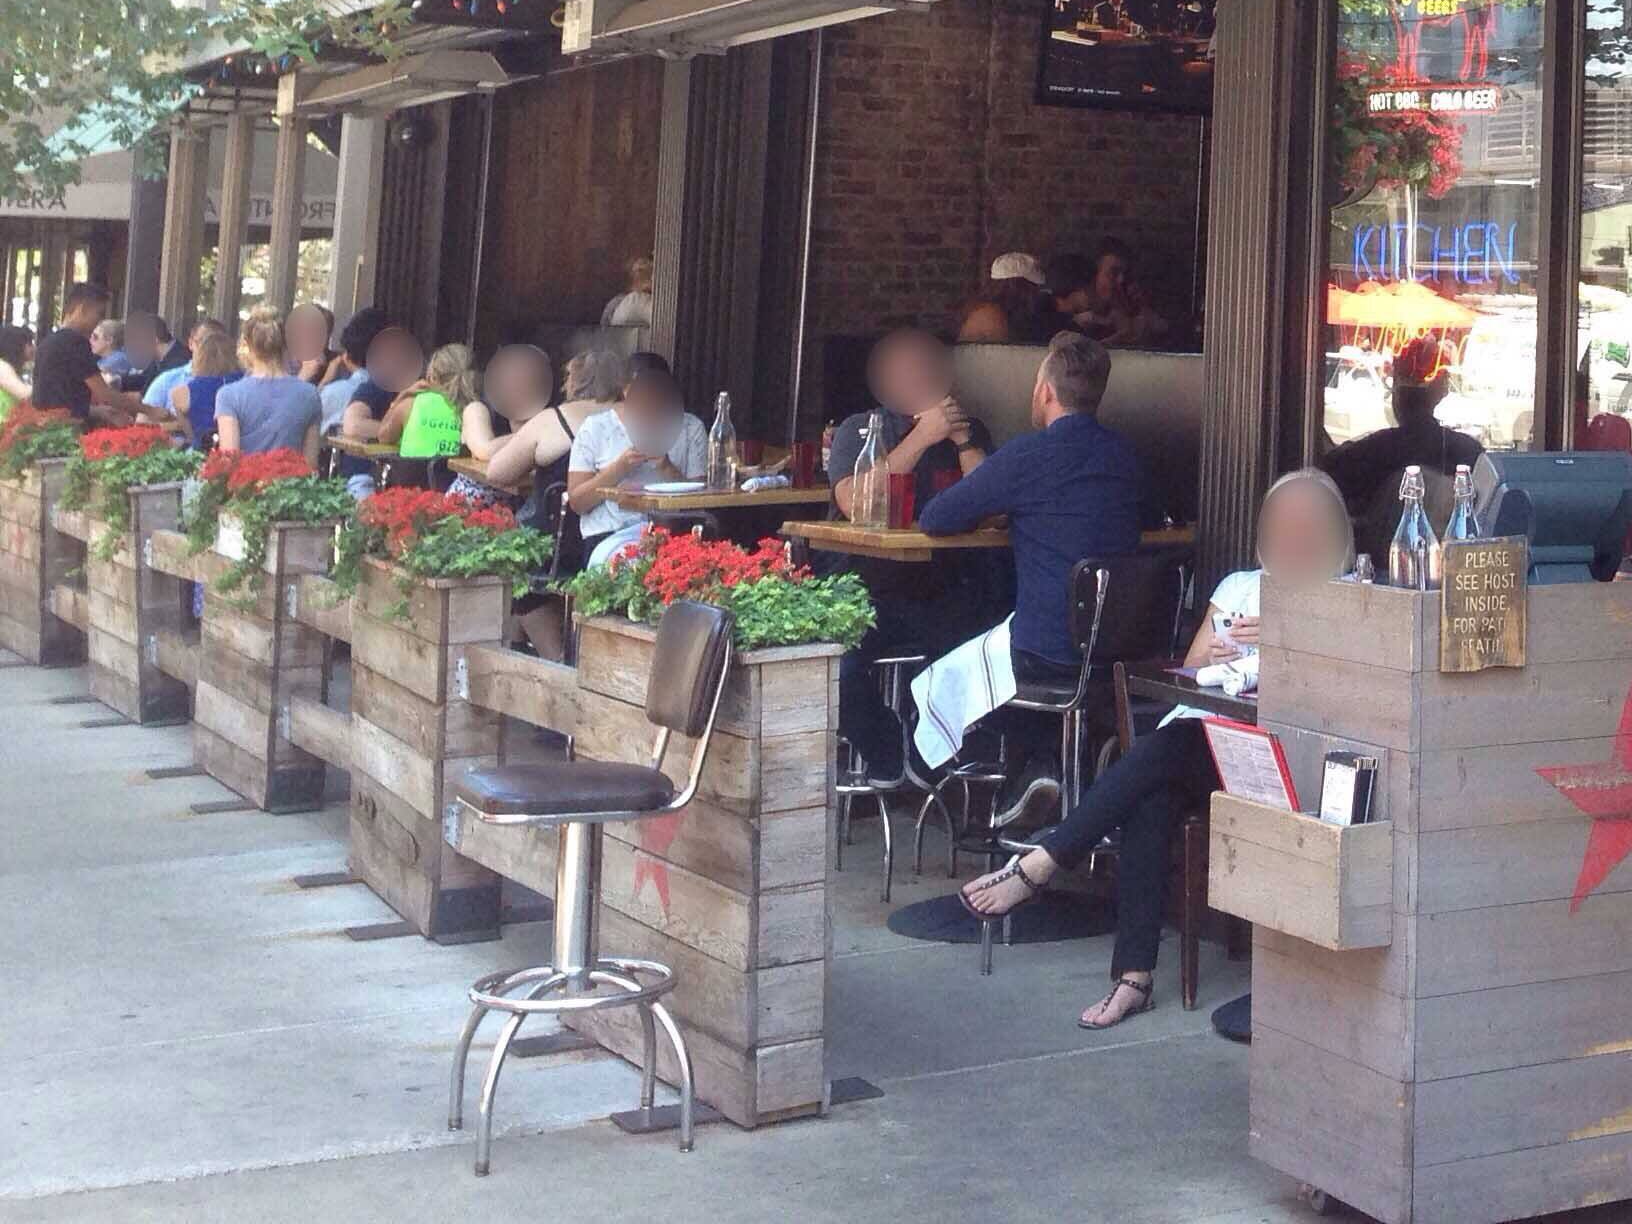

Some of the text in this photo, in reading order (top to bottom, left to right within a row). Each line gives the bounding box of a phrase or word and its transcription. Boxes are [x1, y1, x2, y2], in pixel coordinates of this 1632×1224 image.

[1465, 551, 1510, 568] PLEASE
[1455, 573, 1515, 591] SEE HOST
[1454, 617, 1477, 634] FOR
